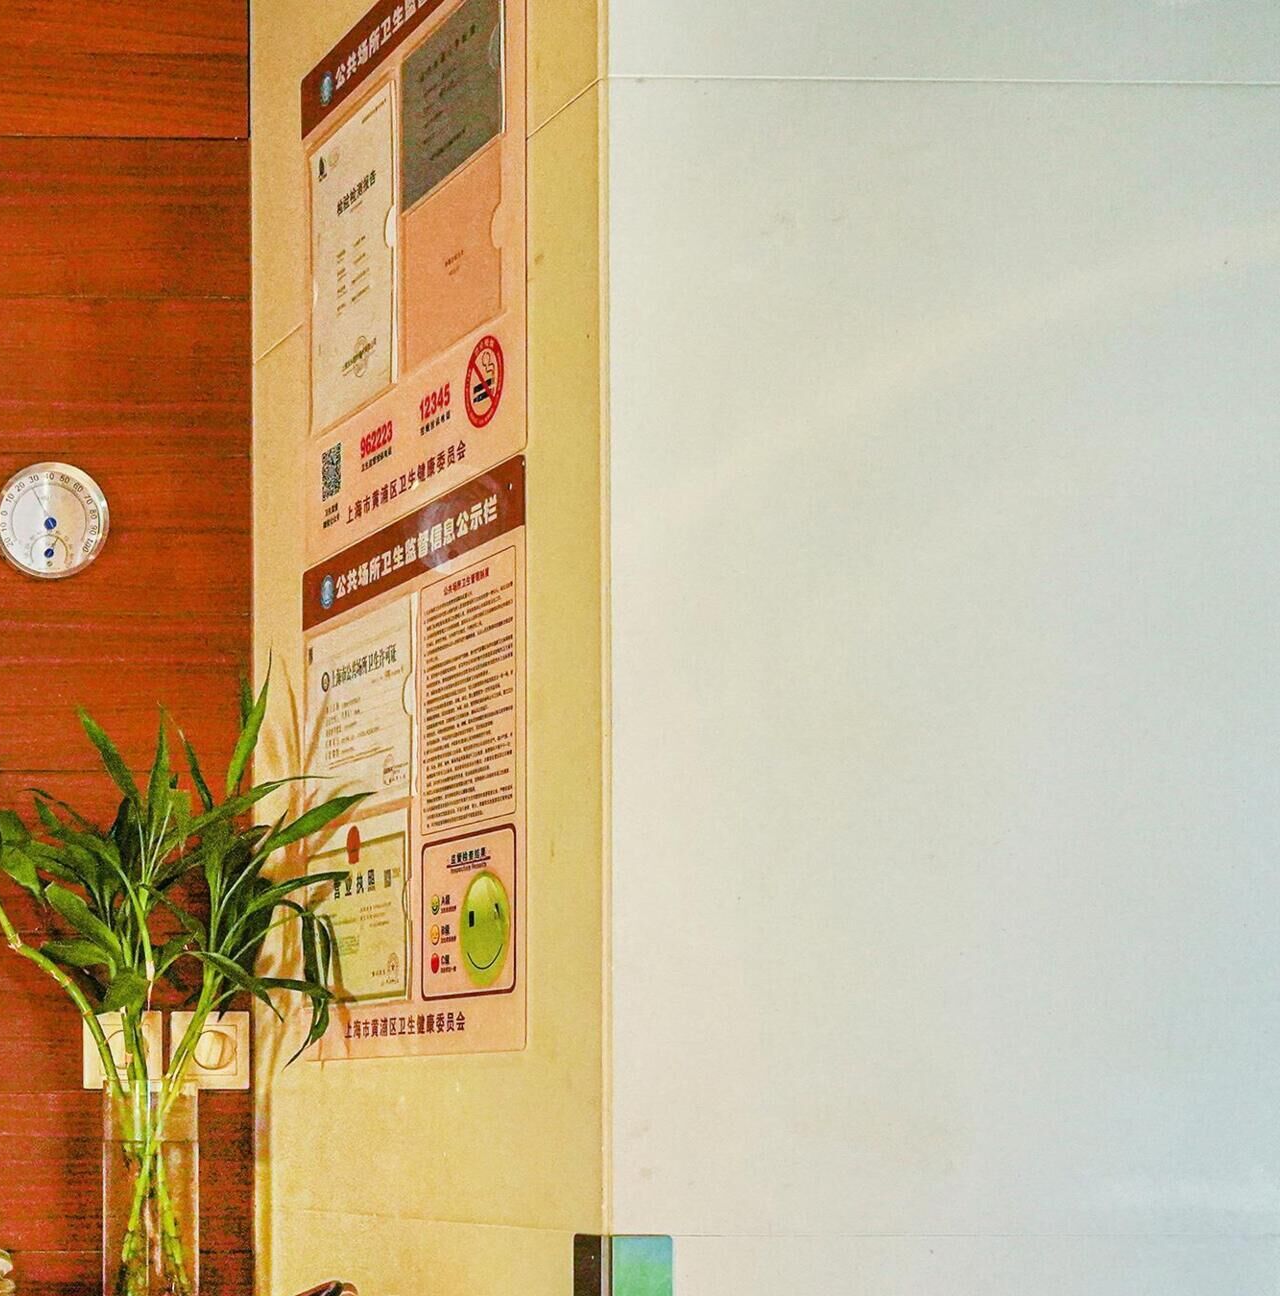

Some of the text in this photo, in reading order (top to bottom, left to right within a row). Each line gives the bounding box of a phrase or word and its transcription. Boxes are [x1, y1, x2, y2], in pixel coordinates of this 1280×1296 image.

[419, 382, 451, 421] 12345
[360, 420, 393, 459] 962223
[15, 482, 26, 492] 20
[28, 474, 40, 484] 30
[60, 475, 70, 484] 50
[73, 482, 83, 493] 60
[346, 439, 466, 525] 上海市黄浦区卫生健康委员会
[335, 494, 498, 599] 公共场所卫生监督信息公示栏
[345, 1010, 466, 1039] 上海市黄浦区卫生健康委员会
